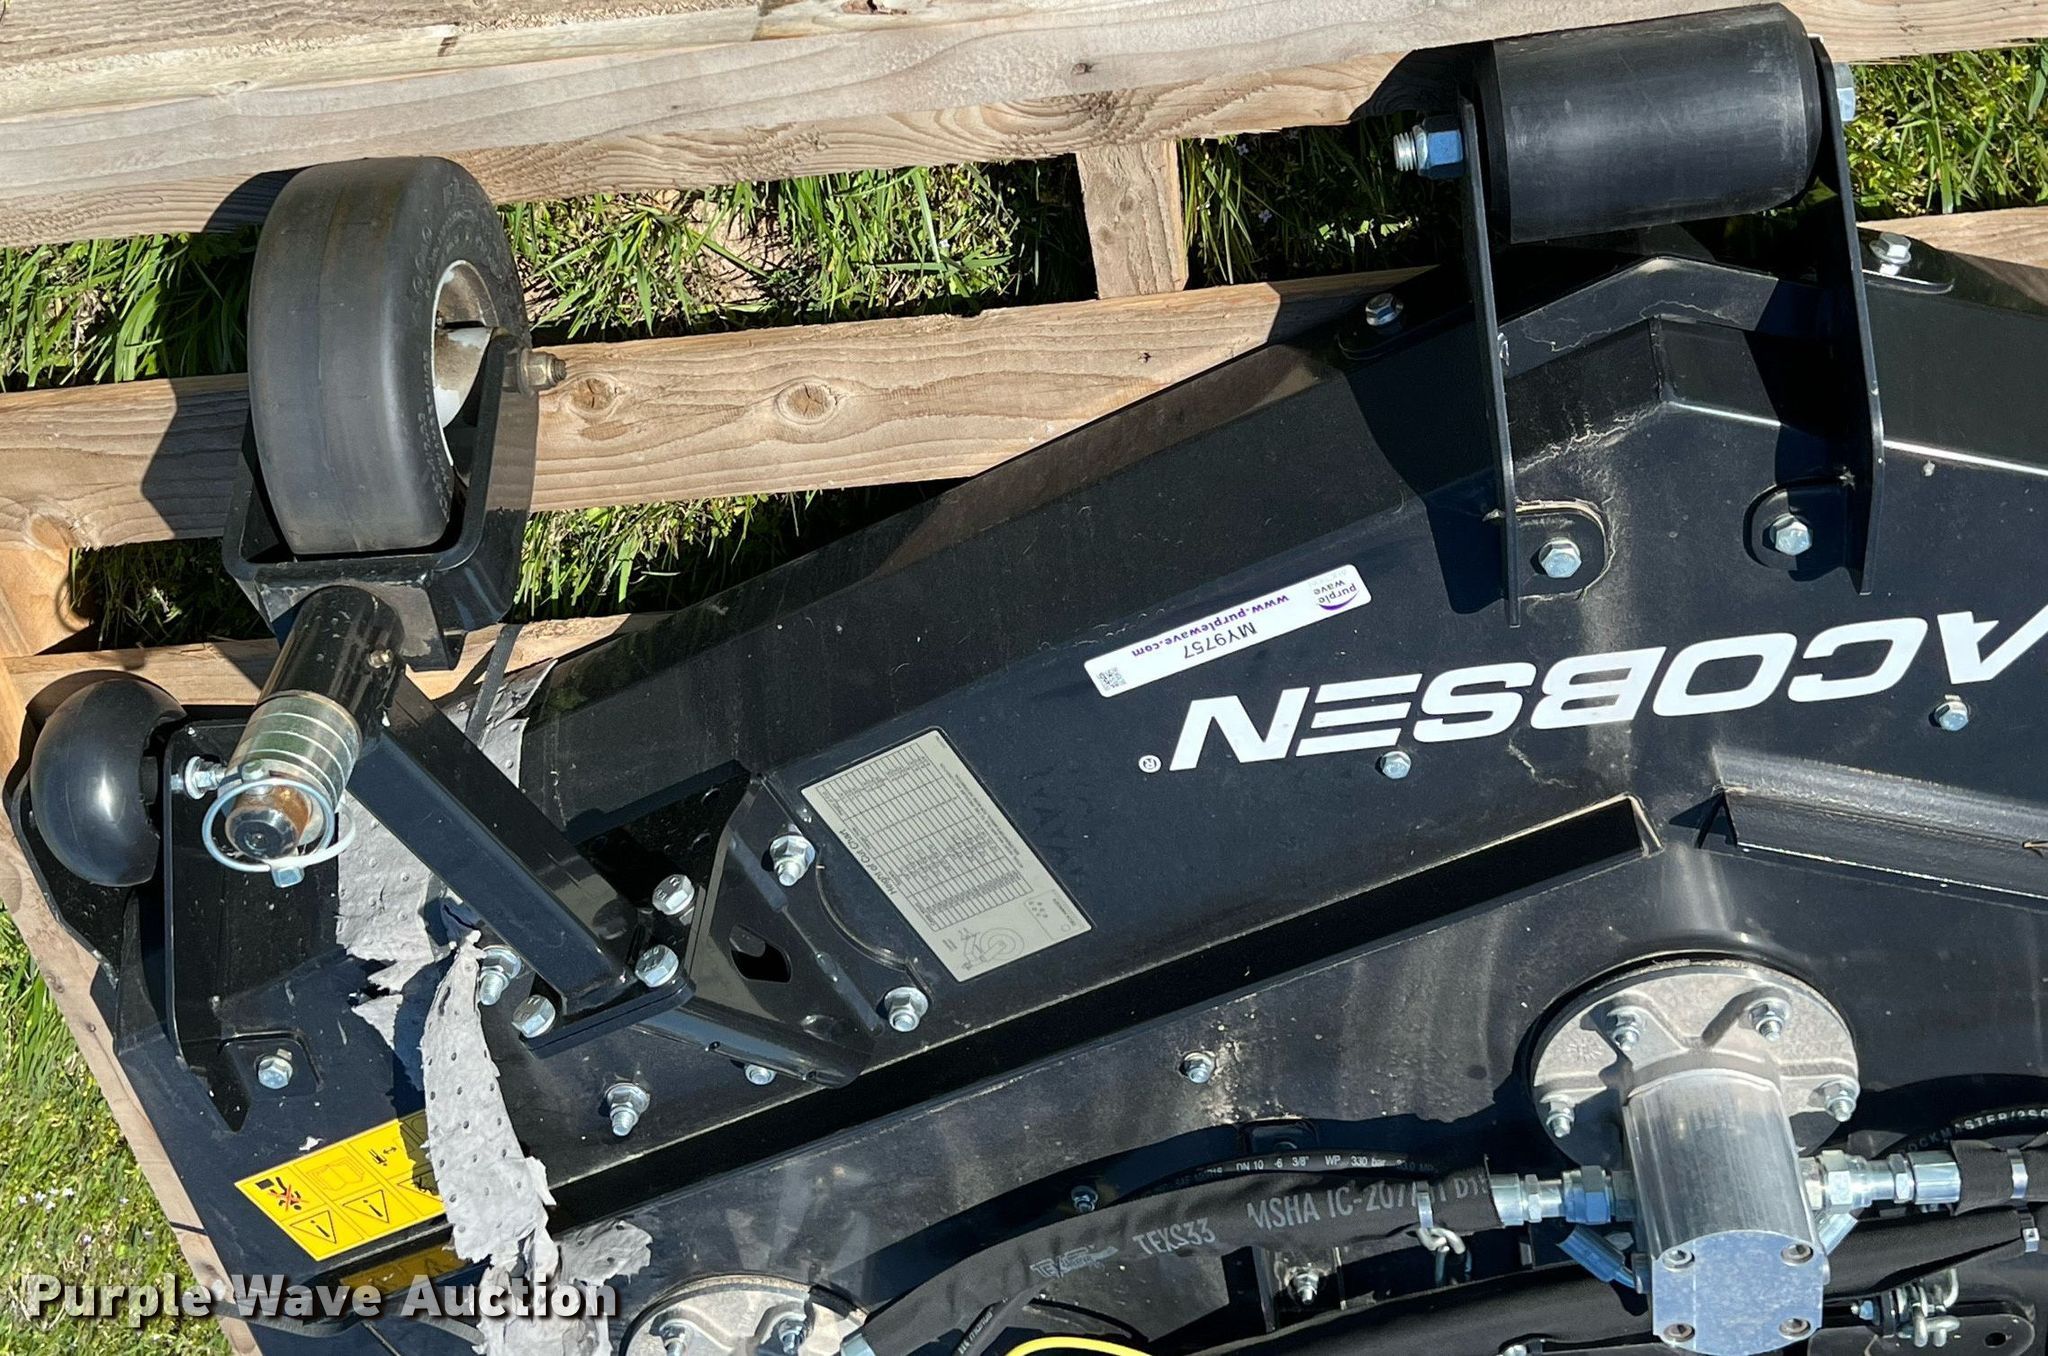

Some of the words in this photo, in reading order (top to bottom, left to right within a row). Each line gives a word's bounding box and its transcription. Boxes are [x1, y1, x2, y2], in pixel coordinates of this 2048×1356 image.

[1313, 579, 1346, 596] wave
[1317, 582, 1357, 605] purple
[1131, 594, 1290, 657] www.purplewave.com
[1183, 621, 1258, 660] MY9757
[1253, 1159, 1264, 1170] 10
[1351, 1155, 1368, 1167] 330
[1247, 1191, 1320, 1231] MSHA
